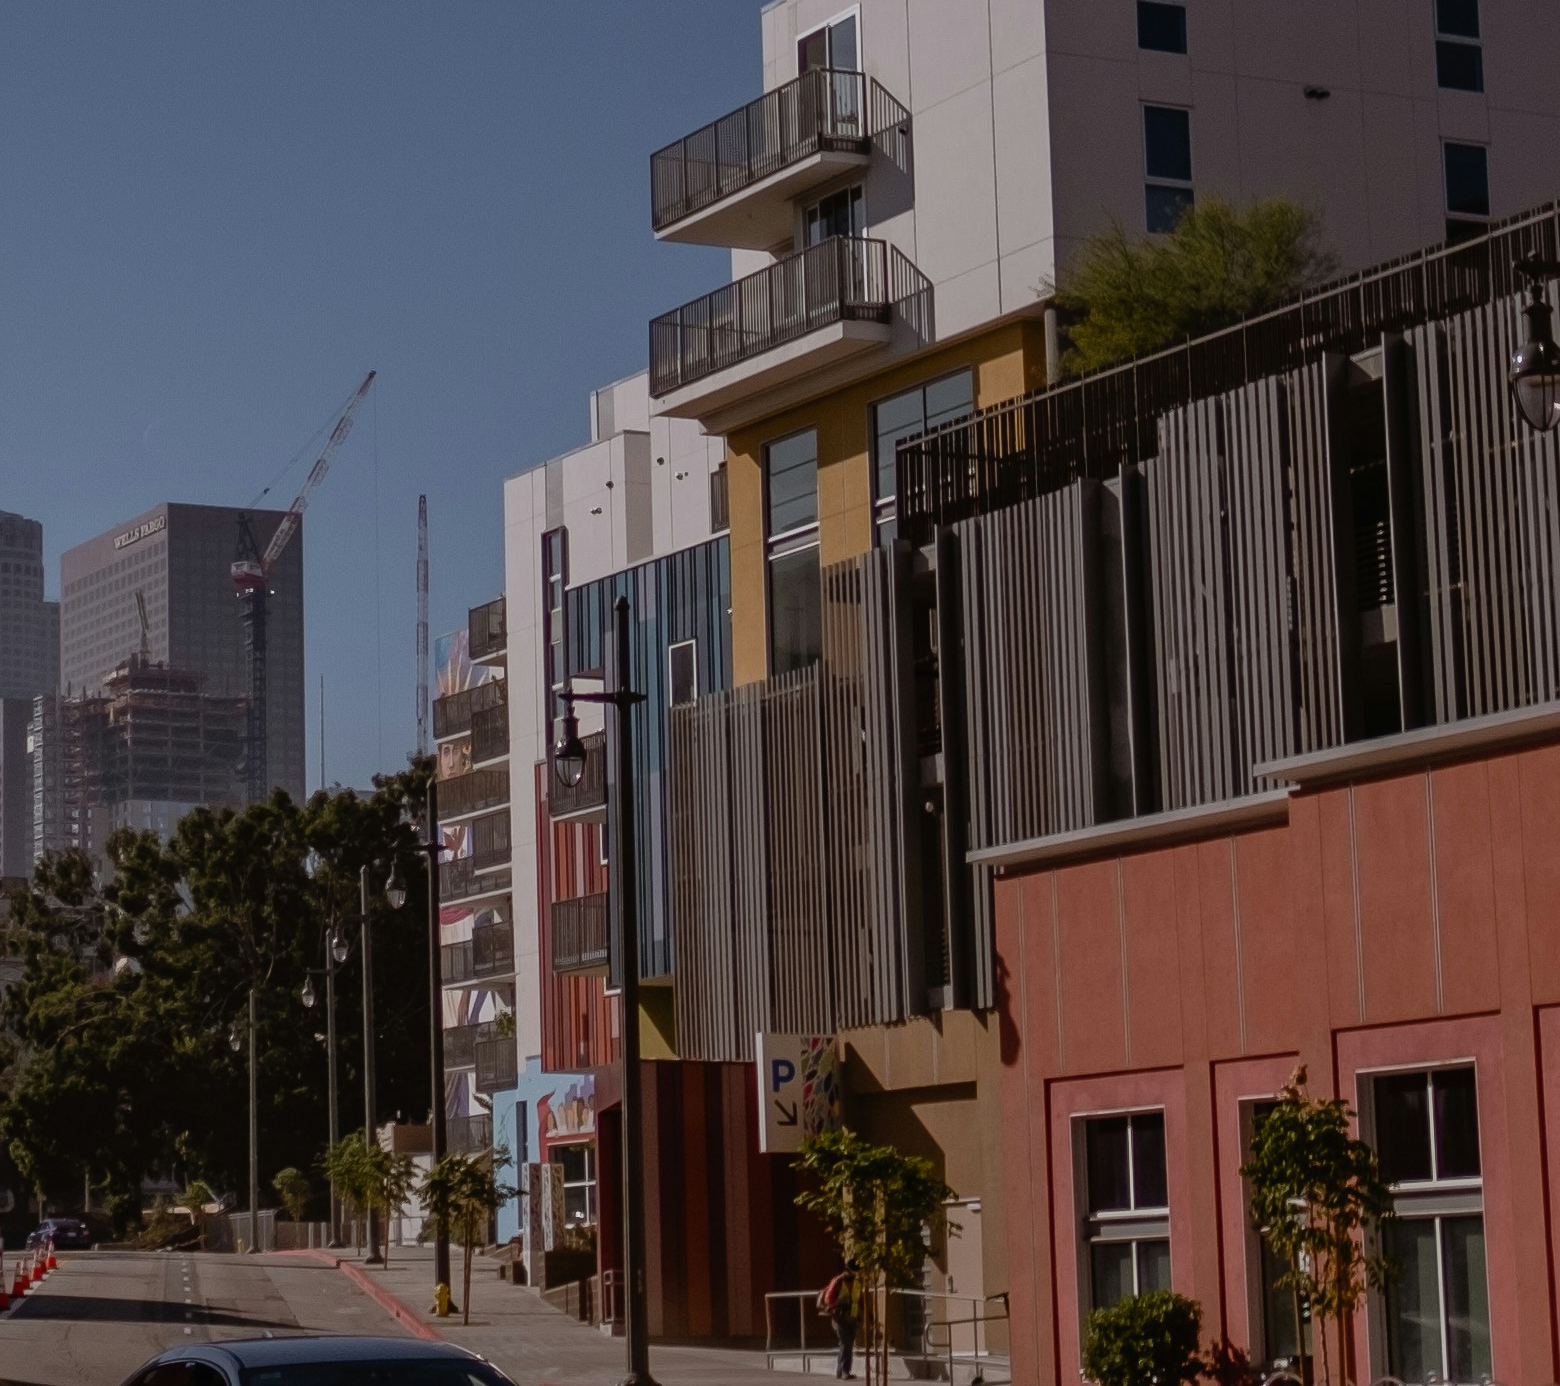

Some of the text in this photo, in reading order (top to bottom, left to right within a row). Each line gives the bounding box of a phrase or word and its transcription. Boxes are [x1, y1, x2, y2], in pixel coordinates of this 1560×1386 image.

[114, 516, 166, 549] WELLS FARGO
[771, 1059, 796, 1093] P
